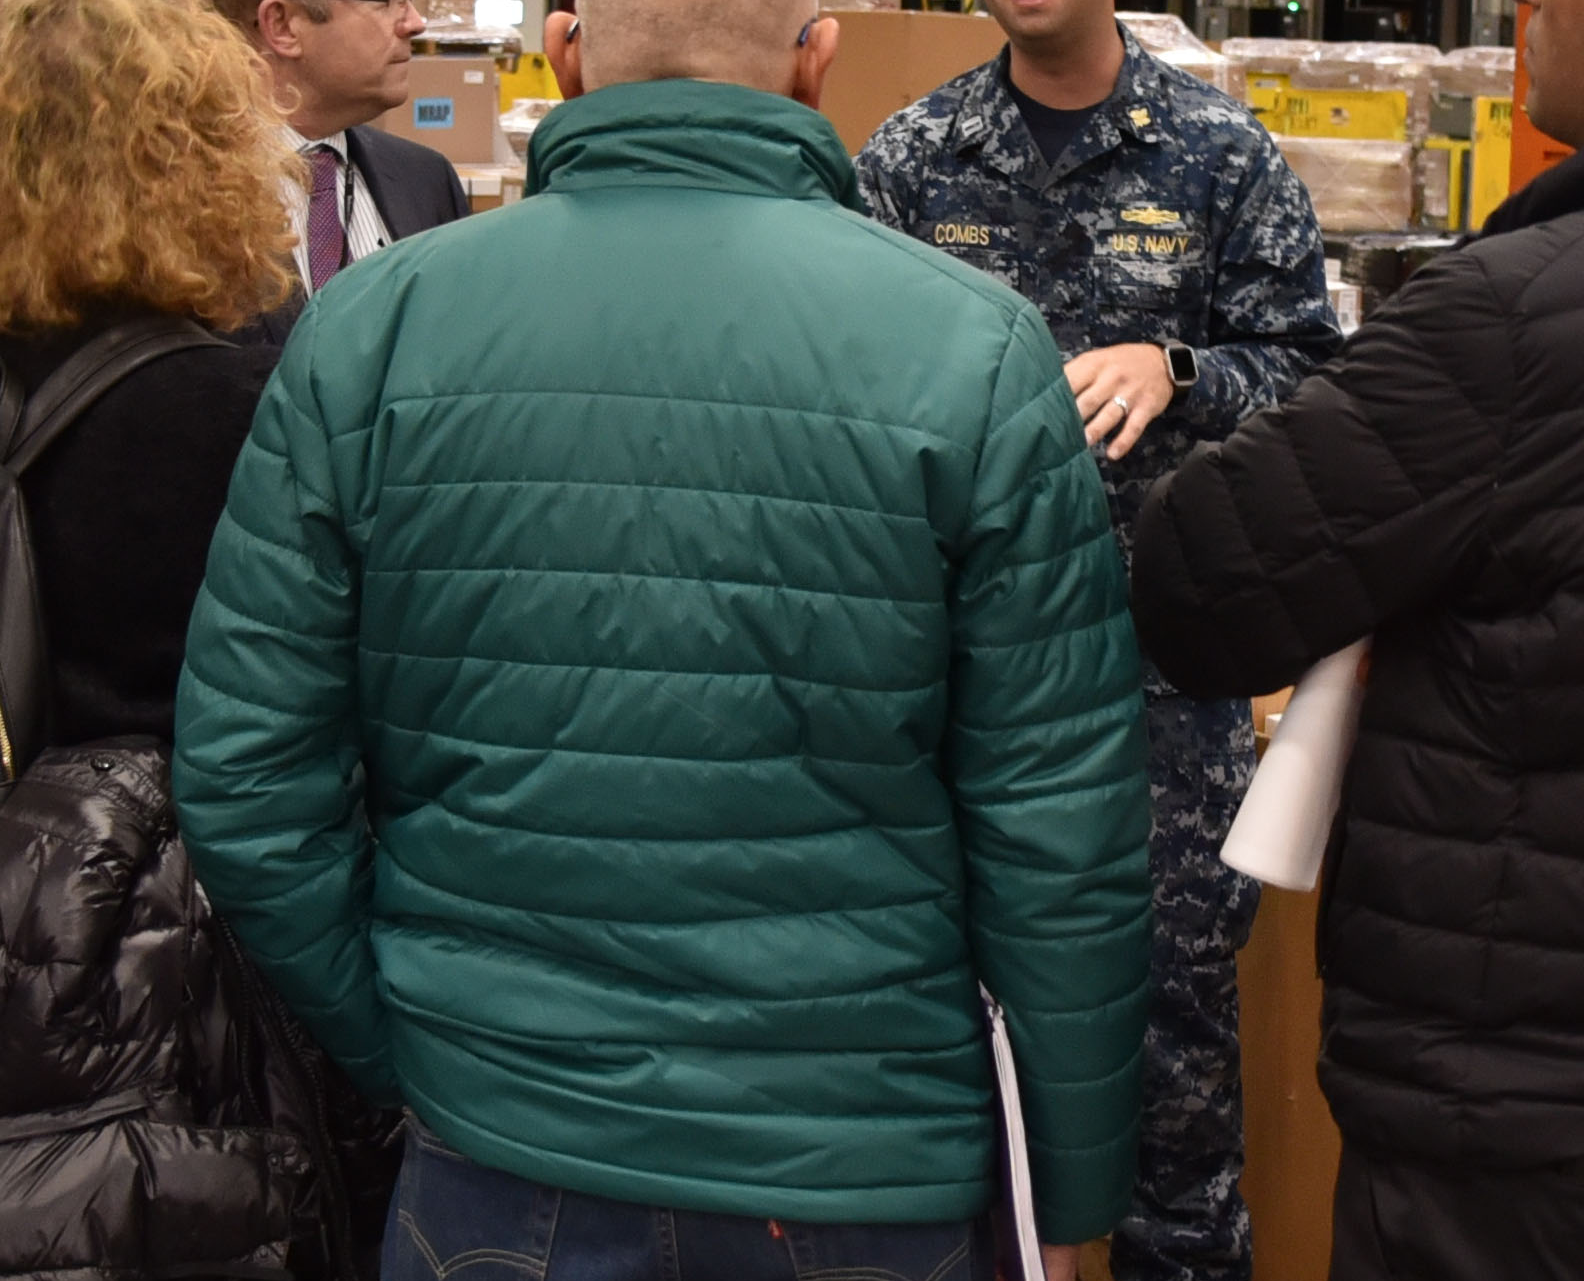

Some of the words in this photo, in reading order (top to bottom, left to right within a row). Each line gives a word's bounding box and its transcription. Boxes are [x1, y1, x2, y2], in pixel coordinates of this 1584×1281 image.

[418, 105, 451, 123] MRAP
[934, 223, 990, 247] COMBS
[1112, 233, 1141, 253] U.S.
[1144, 234, 1189, 254] NAVY
